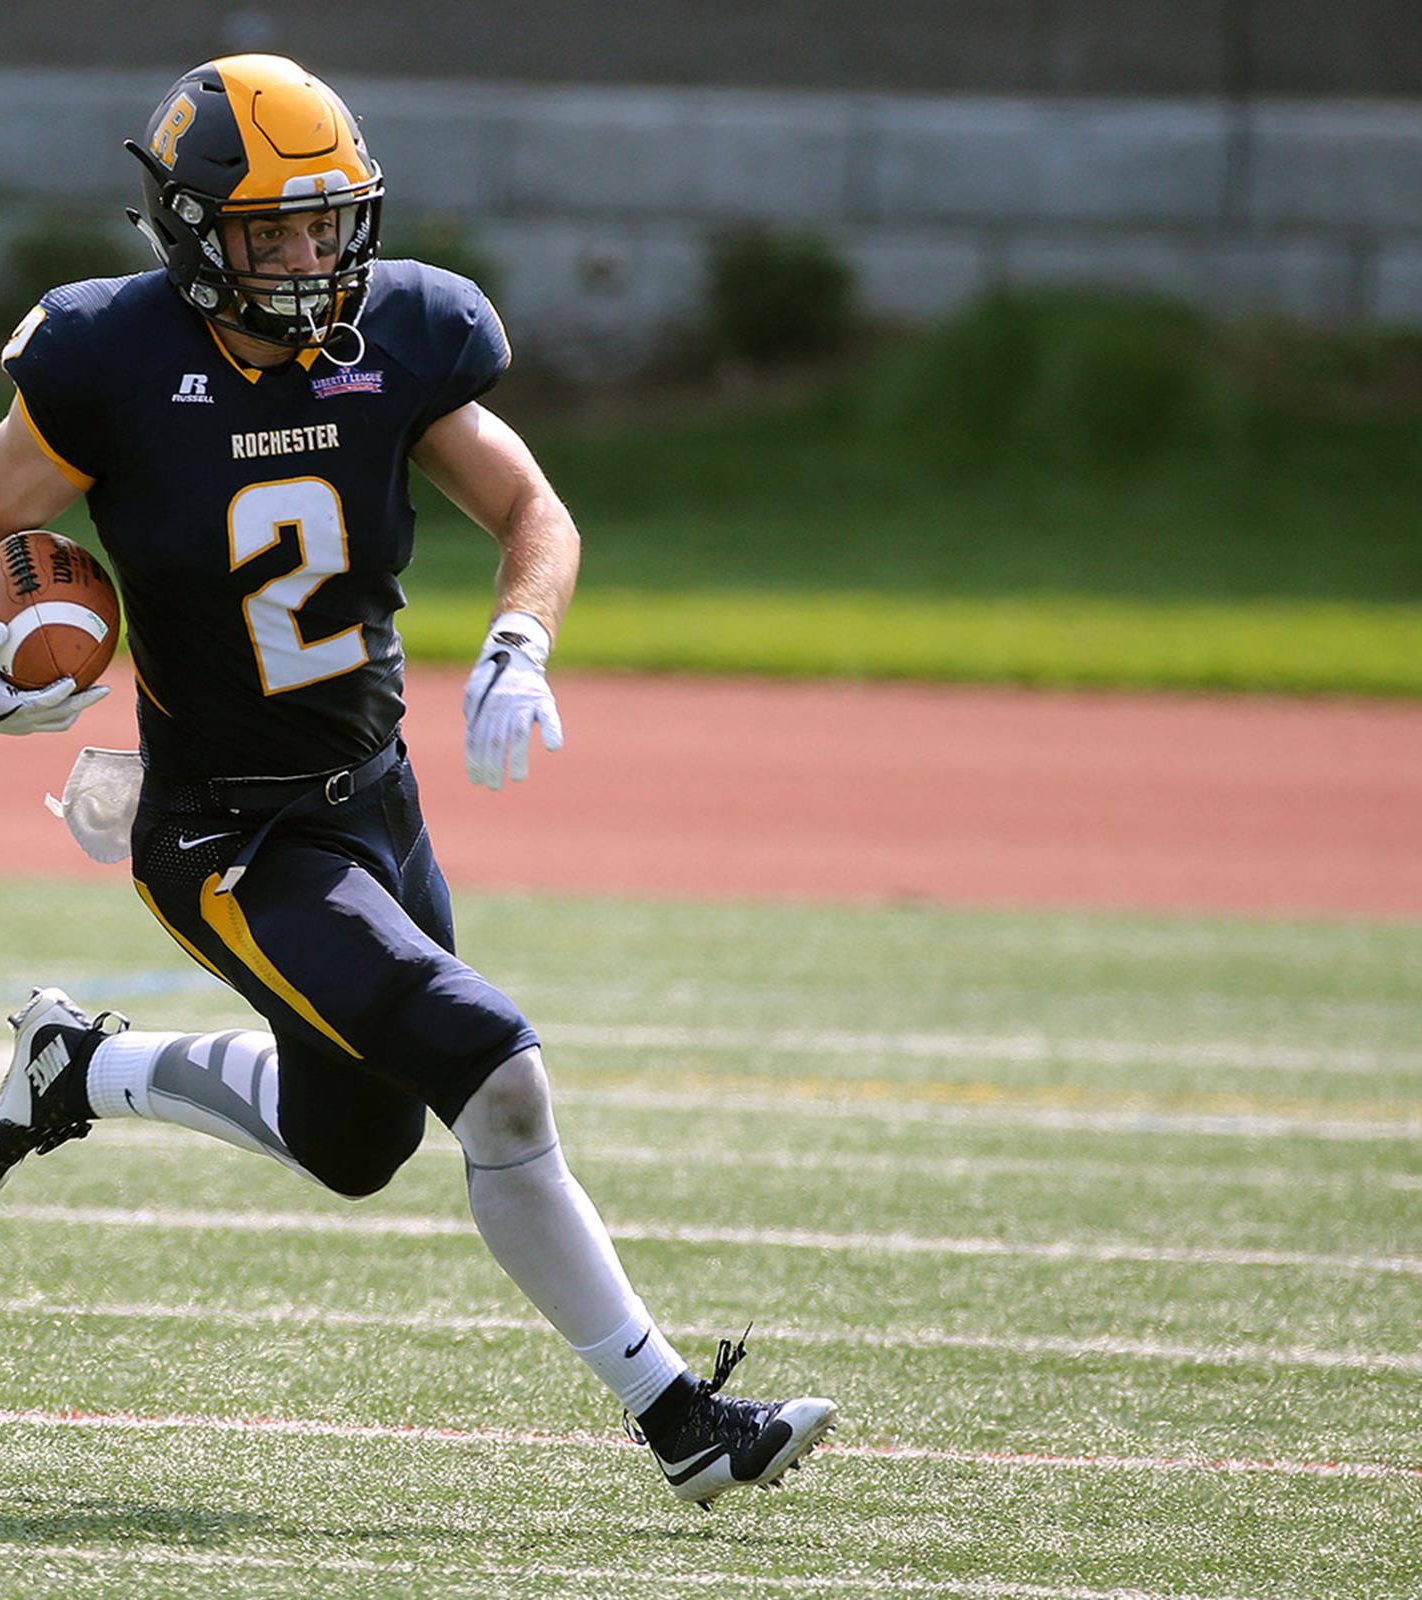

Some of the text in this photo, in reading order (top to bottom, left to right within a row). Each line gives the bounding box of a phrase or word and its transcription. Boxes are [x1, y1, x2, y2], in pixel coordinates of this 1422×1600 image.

[150, 92, 197, 171] R
[171, 393, 214, 404] RUSSELL
[179, 373, 208, 395] R
[312, 375, 347, 389] LIBERTY
[231, 423, 340, 459] ROCHESTER
[226, 475, 370, 697] 2
[25, 1033, 71, 1098] NIKE
